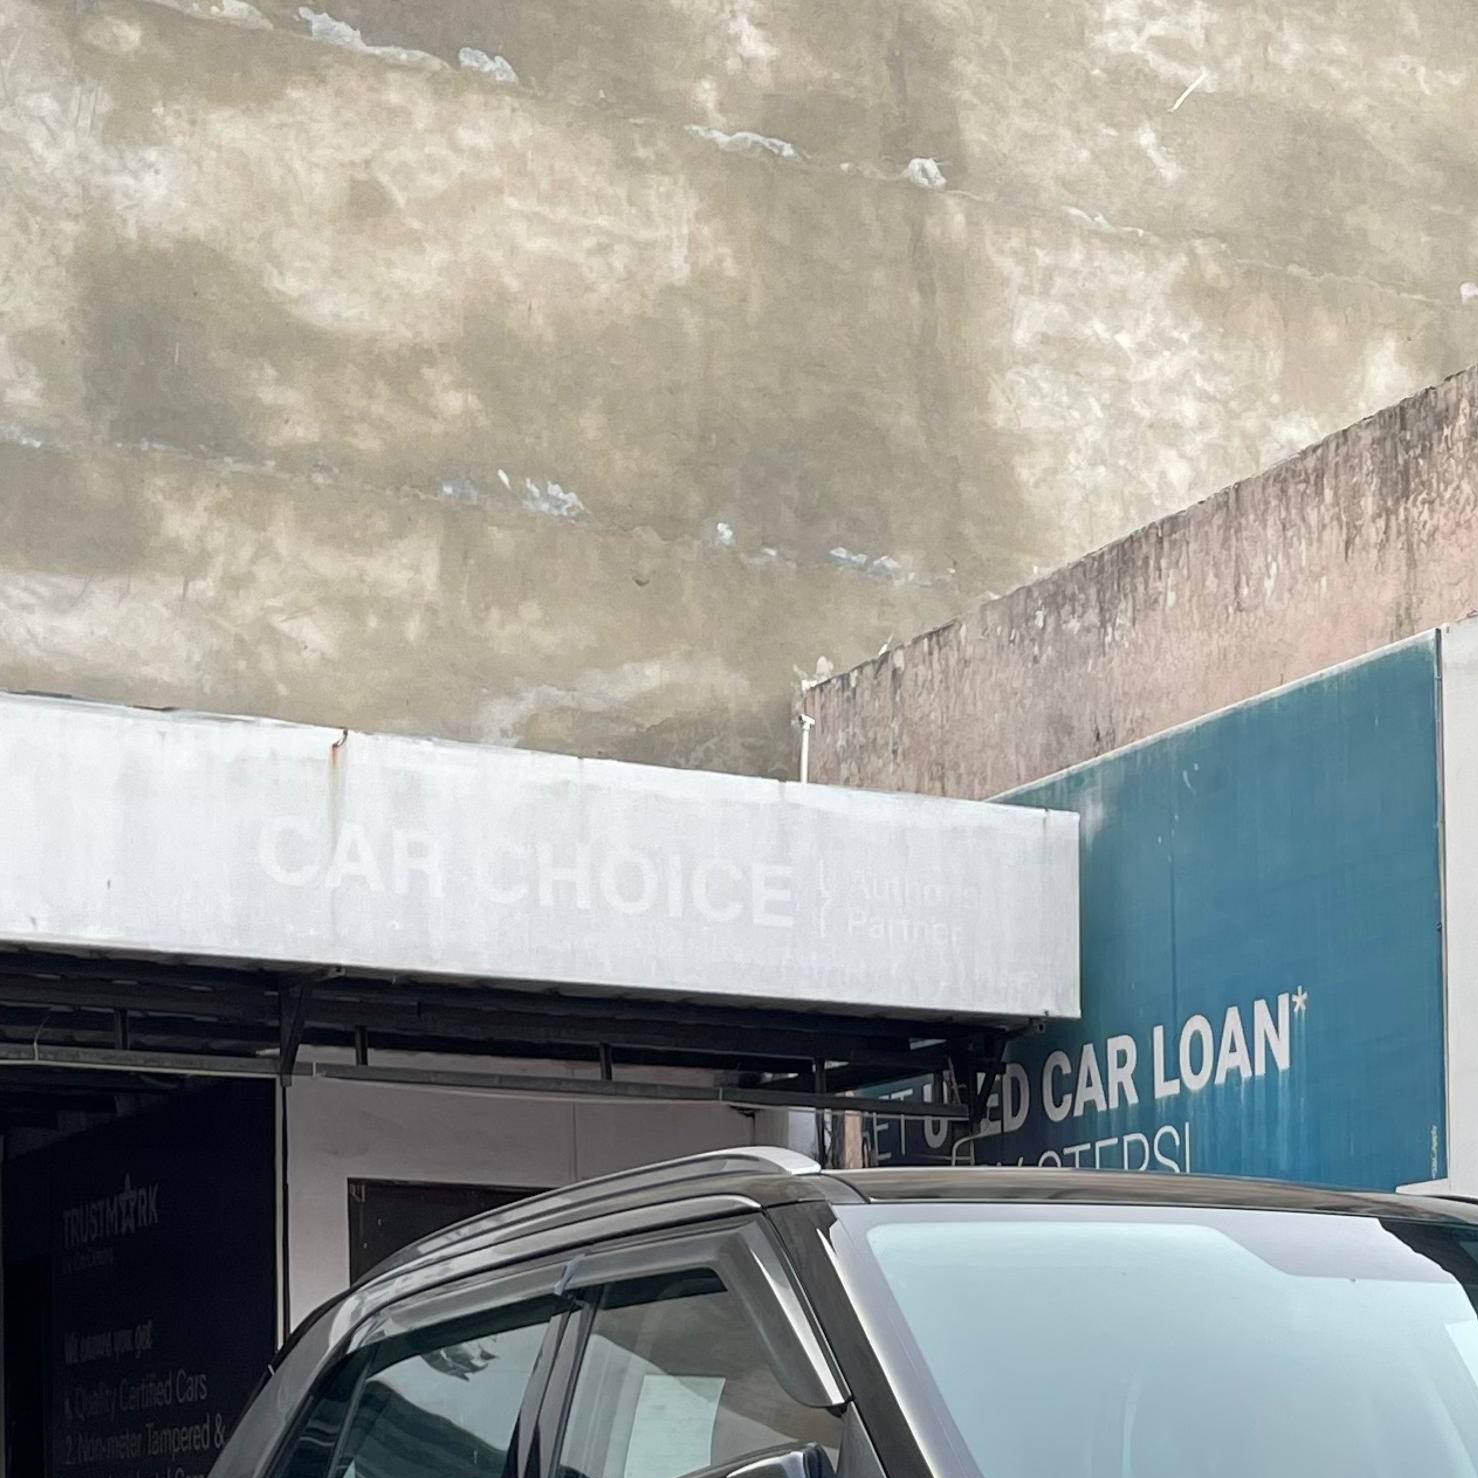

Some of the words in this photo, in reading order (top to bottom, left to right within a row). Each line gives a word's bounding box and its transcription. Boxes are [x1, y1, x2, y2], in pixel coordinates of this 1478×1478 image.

[257, 813, 444, 899] CAR
[474, 837, 796, 928] CHOICE
[1042, 1033, 1139, 1124] CAR
[175, 1369, 208, 1404] Cars
[145, 1412, 211, 1462] Tampered
[213, 1412, 227, 1449] &
